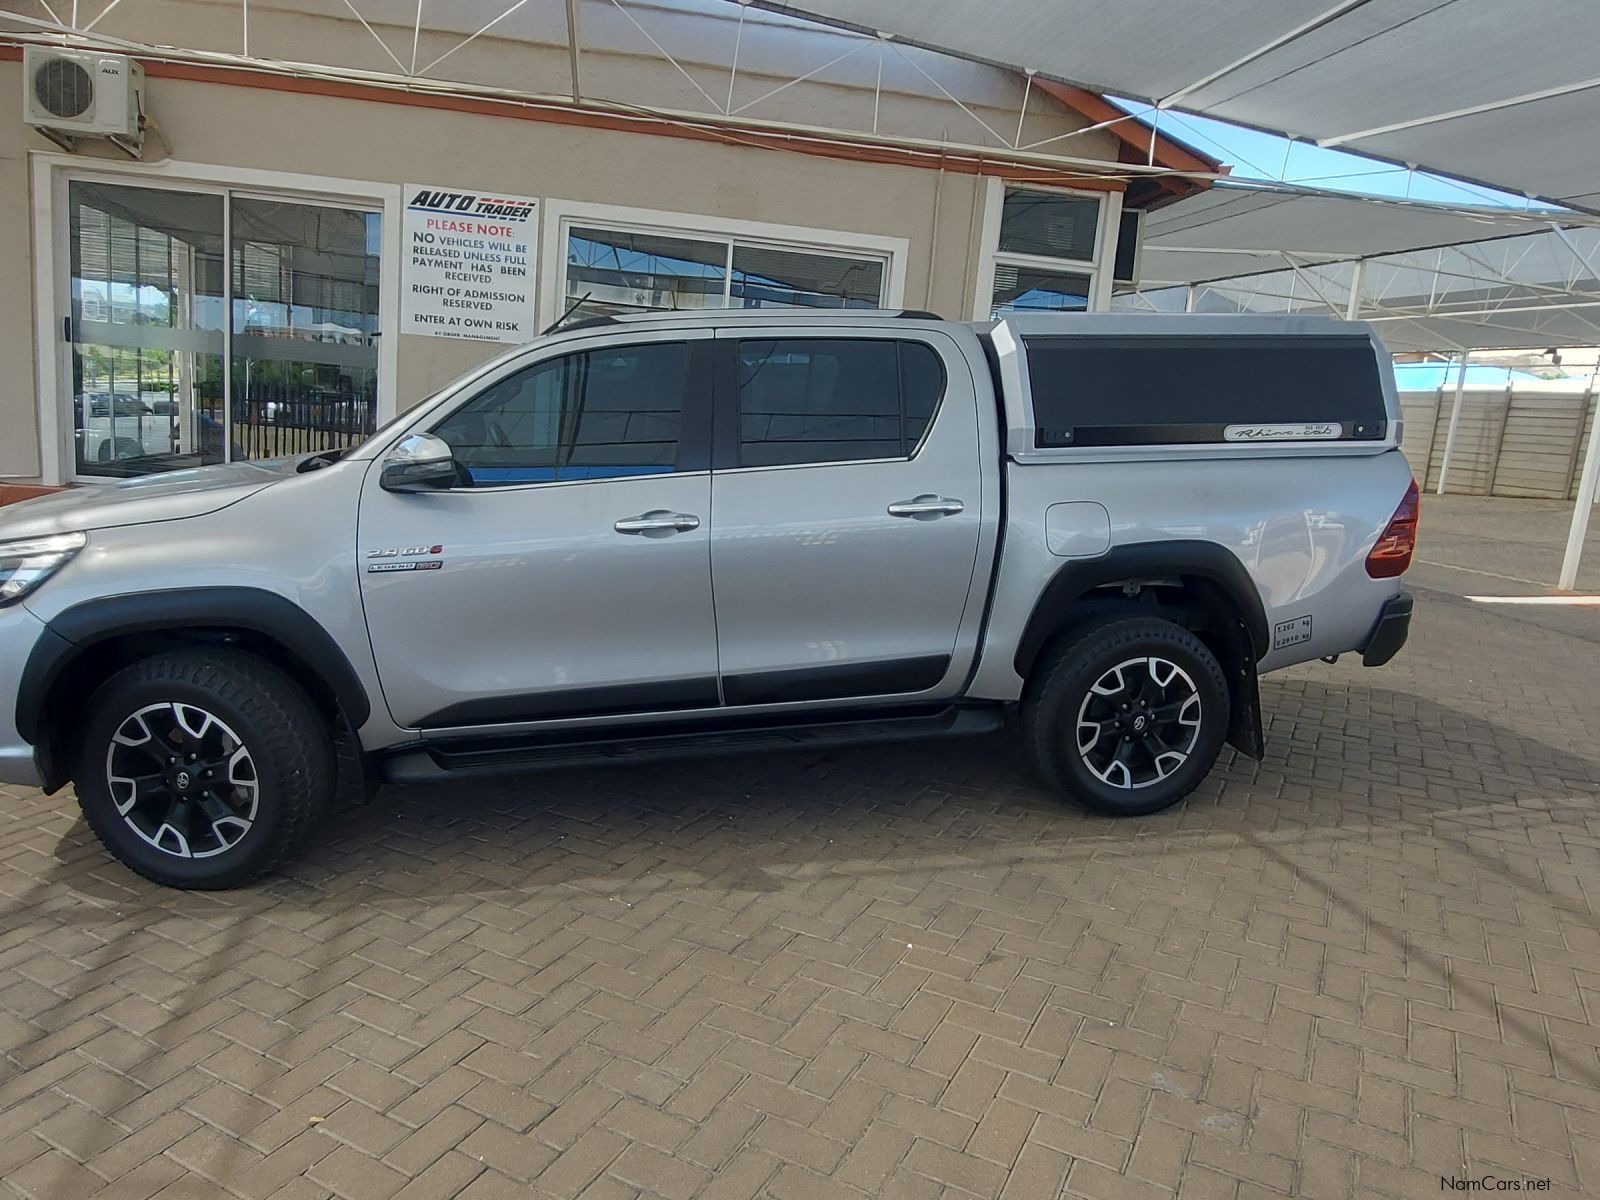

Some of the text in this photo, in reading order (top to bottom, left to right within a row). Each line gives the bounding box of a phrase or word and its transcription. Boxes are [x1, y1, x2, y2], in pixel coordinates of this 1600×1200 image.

[411, 190, 532, 218] AUTO TRADER
[427, 219, 515, 238] PLEASE NOTE:
[413, 232, 527, 253] NO VEHICLES WILL BE
[413, 245, 527, 265] RELEASED UNLESS FULL
[412, 257, 526, 276] PAYMENT HAS BEEN
[412, 284, 525, 303] RIGHT OF ADMISSION
[414, 313, 445, 324] ENTER
[448, 317, 462, 326] AT
[464, 318, 493, 329] OWN
